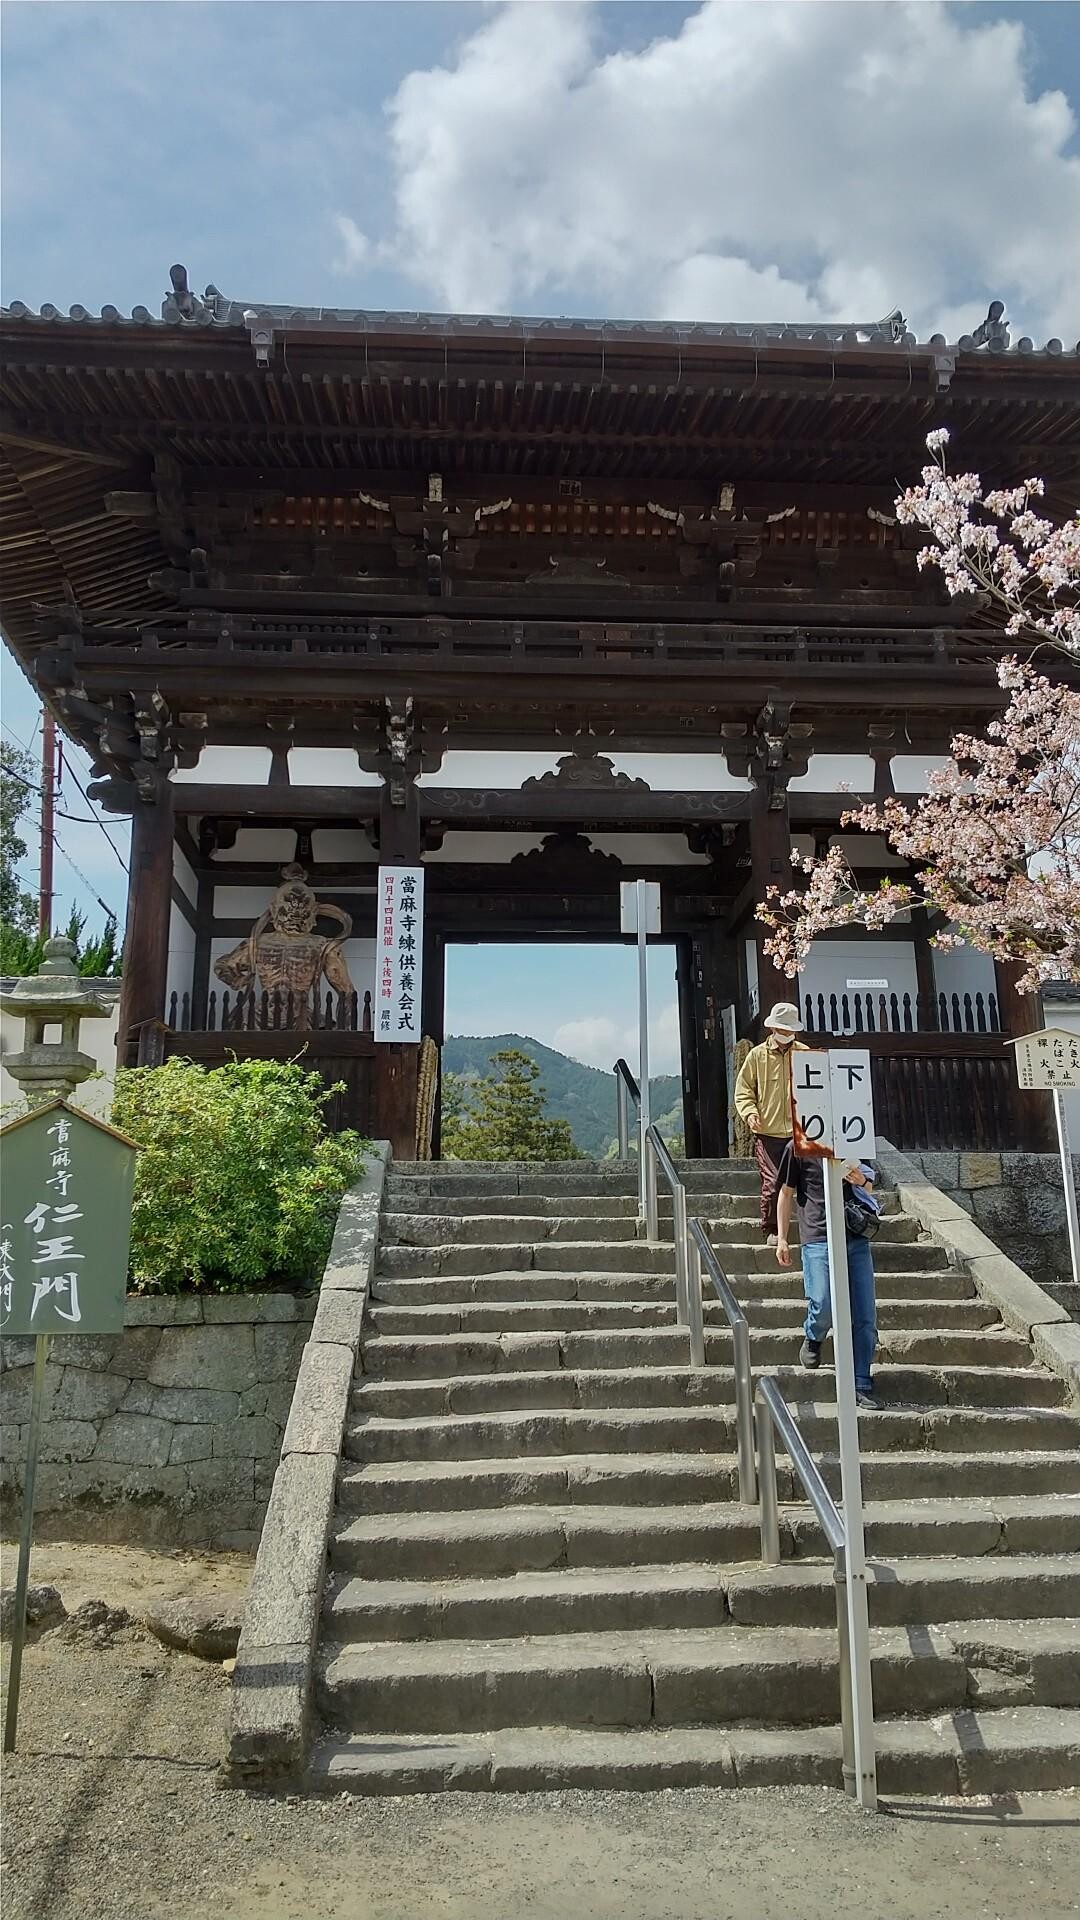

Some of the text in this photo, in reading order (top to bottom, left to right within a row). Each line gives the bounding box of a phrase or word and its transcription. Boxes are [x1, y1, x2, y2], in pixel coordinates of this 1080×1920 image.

[384, 876, 394, 946] 四月十四日開催
[382, 956, 392, 998] 午後四時
[398, 876, 417, 1031] 當麻寺練供養会式
[1047, 1070, 1072, 1080] 禁止
[1053, 1039, 1065, 1068] たばこ
[1068, 1039, 1080, 1068] たき火
[797, 1064, 824, 1141] 上り
[837, 1064, 866, 1142] 下り
[24, 1202, 86, 1322] 仁王門
